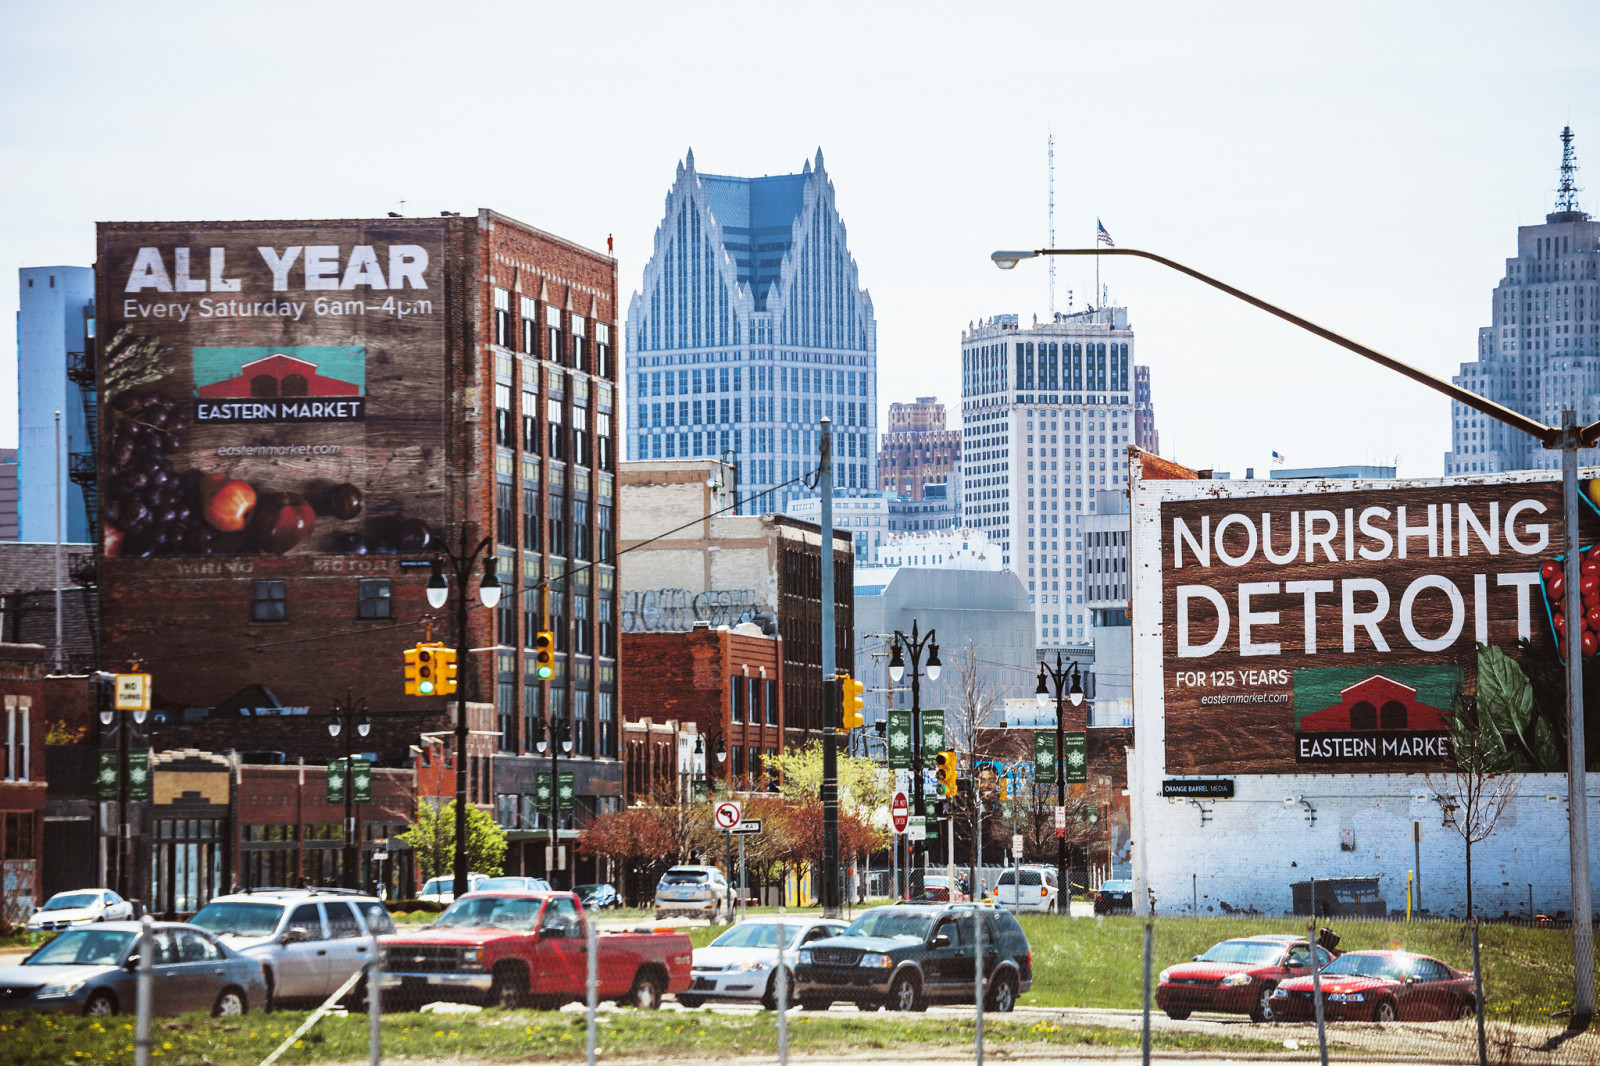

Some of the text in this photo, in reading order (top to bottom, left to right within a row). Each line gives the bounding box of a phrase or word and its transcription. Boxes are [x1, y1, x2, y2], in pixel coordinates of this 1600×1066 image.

[123, 244, 429, 293] ALL YEAR
[123, 299, 190, 322] Every
[198, 298, 306, 321] Saturday
[197, 401, 361, 420] EASTERN MARKET
[217, 443, 342, 456] easternmarket.com
[1173, 499, 1550, 569] NOURISHING
[1176, 571, 1542, 658] DETROIT
[1176, 669, 1289, 687] FOR 125 YEARS
[1201, 692, 1289, 705] easternmarket.com
[1300, 736, 1451, 758] EASTERN MARKE
[1164, 785, 1187, 793] ORANGE
[894, 799, 899, 807] DO
[895, 817, 906, 825] ENTER
